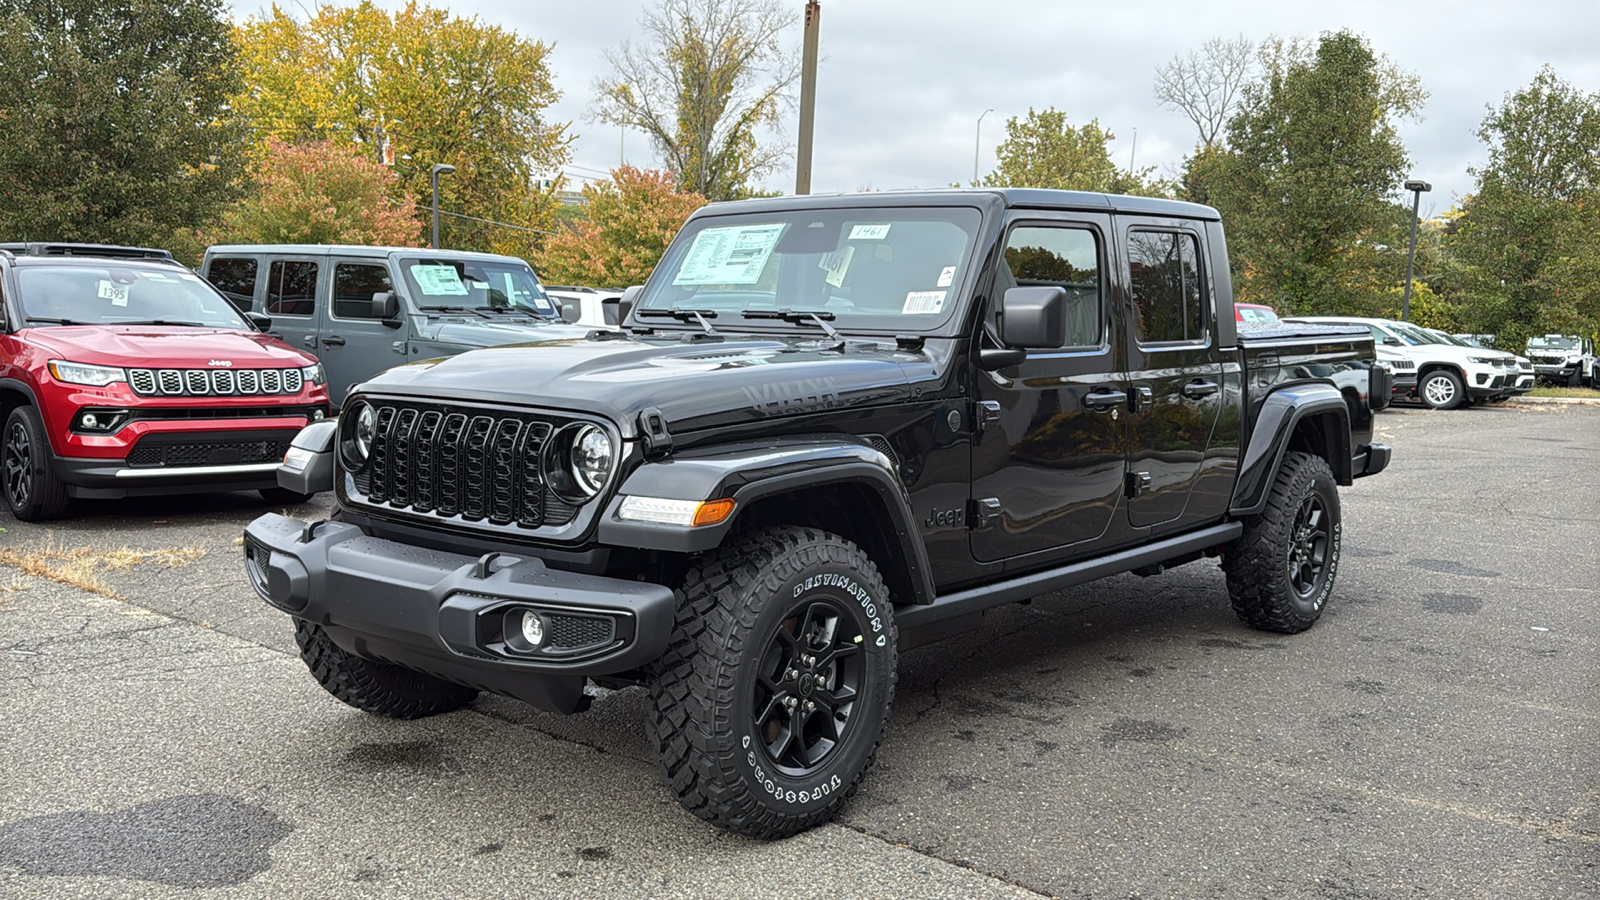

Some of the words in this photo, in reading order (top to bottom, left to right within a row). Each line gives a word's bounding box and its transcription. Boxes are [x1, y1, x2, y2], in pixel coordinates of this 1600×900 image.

[856, 226, 883, 236] 1461
[103, 287, 126, 300] 1395
[207, 359, 233, 368] Jeep
[924, 506, 963, 529] Jeep
[793, 573, 882, 632] DESTINATION
